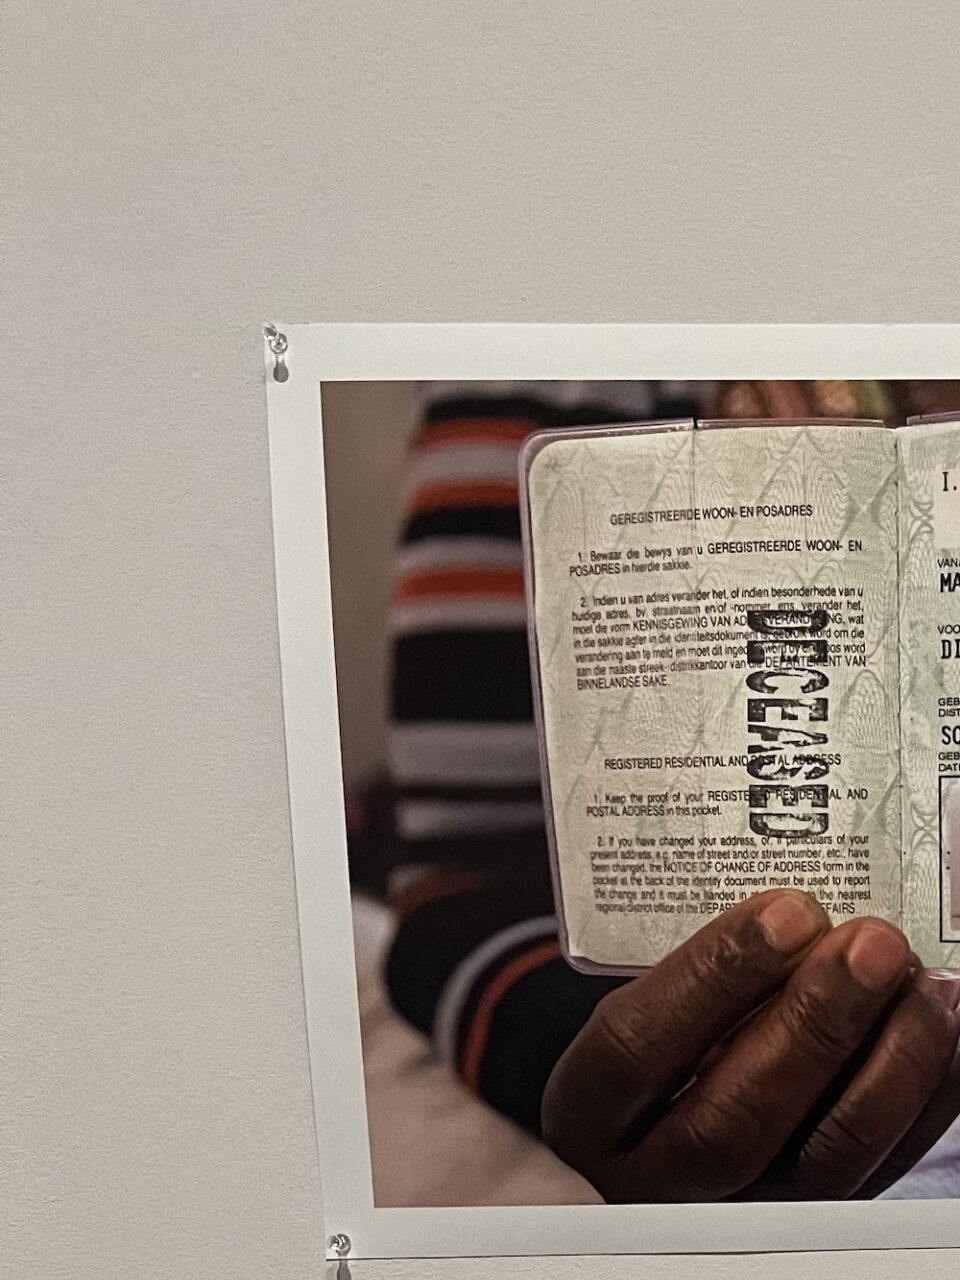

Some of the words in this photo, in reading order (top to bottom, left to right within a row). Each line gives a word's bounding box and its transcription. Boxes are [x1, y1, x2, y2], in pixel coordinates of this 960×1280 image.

[610, 509, 700, 525] GEREGISTREERDE
[703, 508, 737, 519] WOON-
[740, 507, 754, 518] EN
[756, 505, 813, 517] POSADRES
[707, 540, 801, 554] GEREGISTREERDE
[806, 540, 843, 550] WOON-
[848, 540, 862, 550] EN
[570, 564, 620, 576] POSADRES
[633, 616, 708, 630] KENNISGEWING
[710, 615, 730, 626] VAN
[846, 656, 866, 666] VAN
[577, 677, 640, 690] BINNELANDSE
[746, 610, 829, 838] DECEASED
[604, 758, 662, 769] REGISTERED
[665, 756, 726, 768] RESIDENTIAL
[728, 755, 748, 766] AND
[586, 806, 620, 816] POSTAL
[622, 806, 664, 816] ADDRESS
[761, 849, 786, 858] street
[788, 848, 825, 859] number,
[848, 848, 869, 857] have
[664, 862, 697, 872] NOTICE
[700, 862, 712, 872] OF
[715, 861, 755, 872] CHANGE
[758, 861, 771, 871] OF
[773, 861, 820, 871] ADDRESS
[823, 861, 843, 871] form
[846, 861, 853, 871] in
[855, 860, 870, 871] the
[725, 876, 766, 885] document
[770, 876, 790, 885] must
[793, 876, 804, 885] be
[807, 876, 829, 885] used
[832, 876, 841, 885] to
[844, 876, 870, 887] report
[838, 890, 871, 899] nearest
